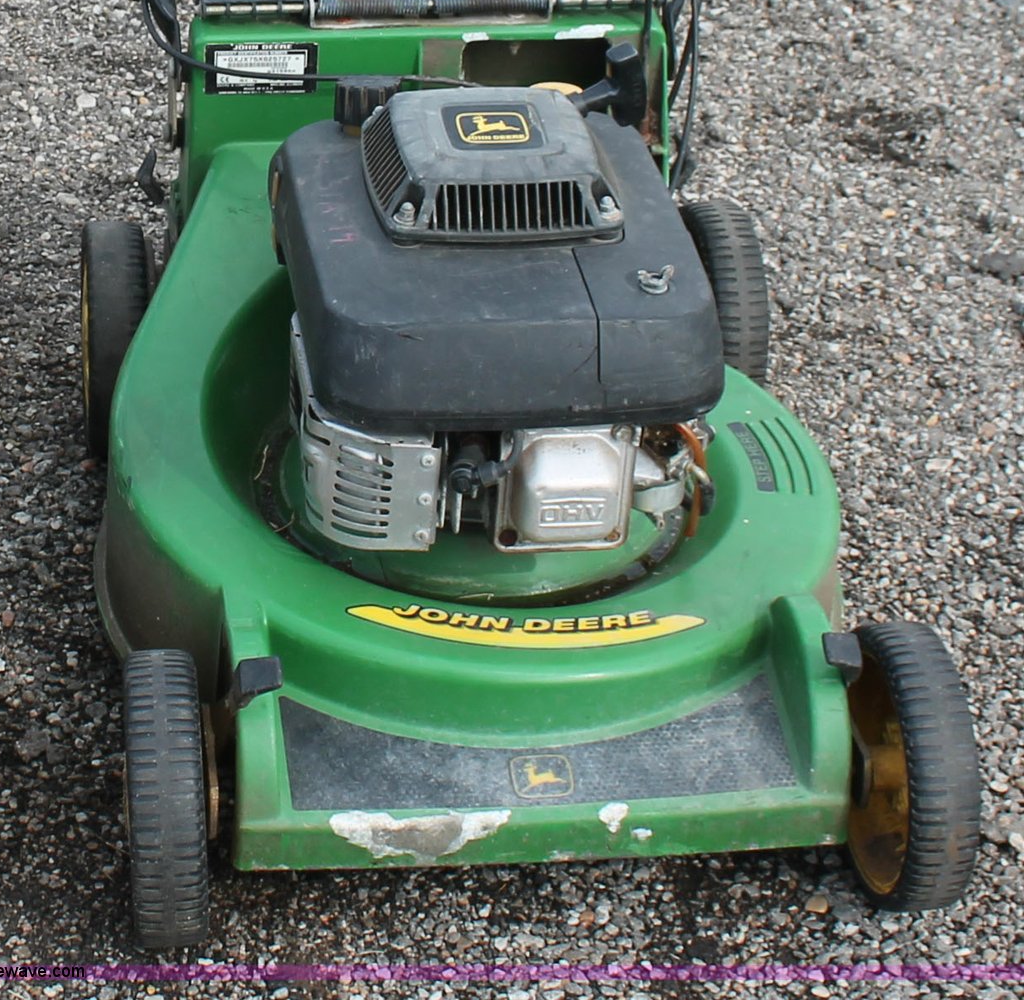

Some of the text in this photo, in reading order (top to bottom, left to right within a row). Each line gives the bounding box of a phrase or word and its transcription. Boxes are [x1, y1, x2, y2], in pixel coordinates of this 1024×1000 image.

[540, 504, 604, 521] OHV
[392, 604, 657, 633] JOHN DEERE
